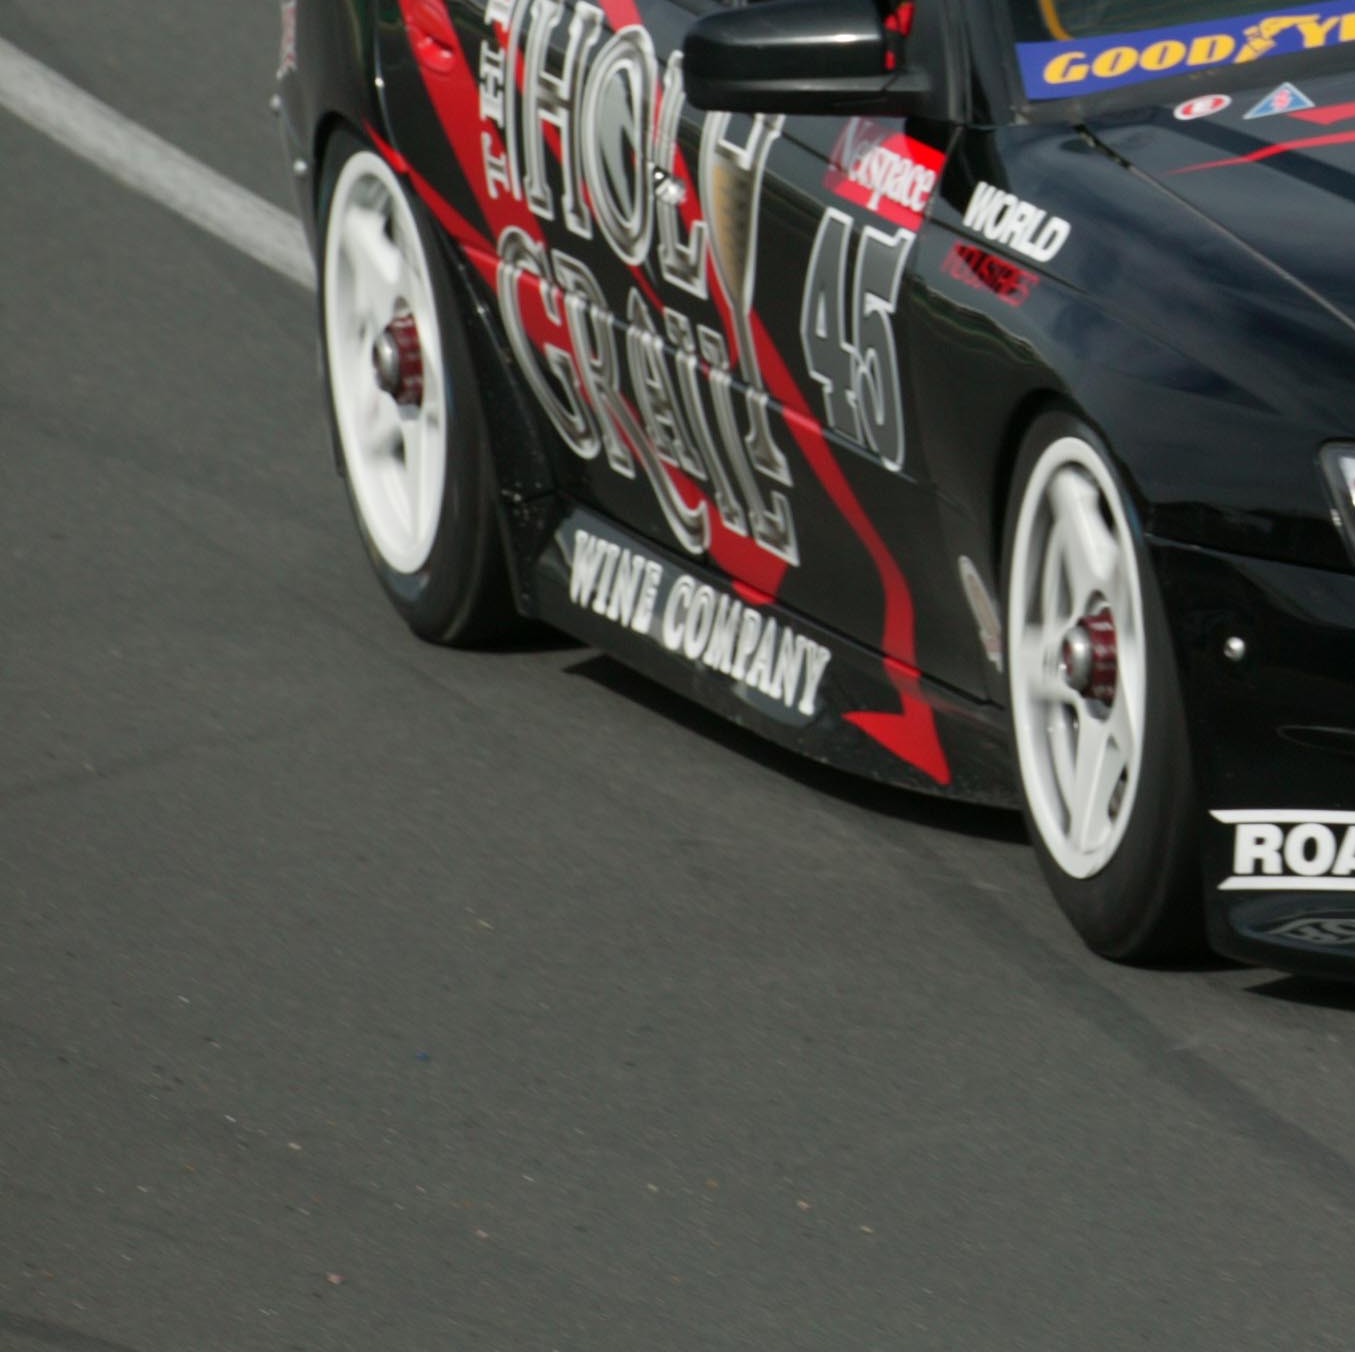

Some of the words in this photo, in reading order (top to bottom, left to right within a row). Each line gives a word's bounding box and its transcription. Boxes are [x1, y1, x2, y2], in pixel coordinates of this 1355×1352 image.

[963, 181, 1072, 264] WORLD
[497, 226, 800, 567] GRAIL
[801, 207, 916, 473] 45
[571, 529, 665, 634] WINE
[662, 574, 832, 716] COMPANY
